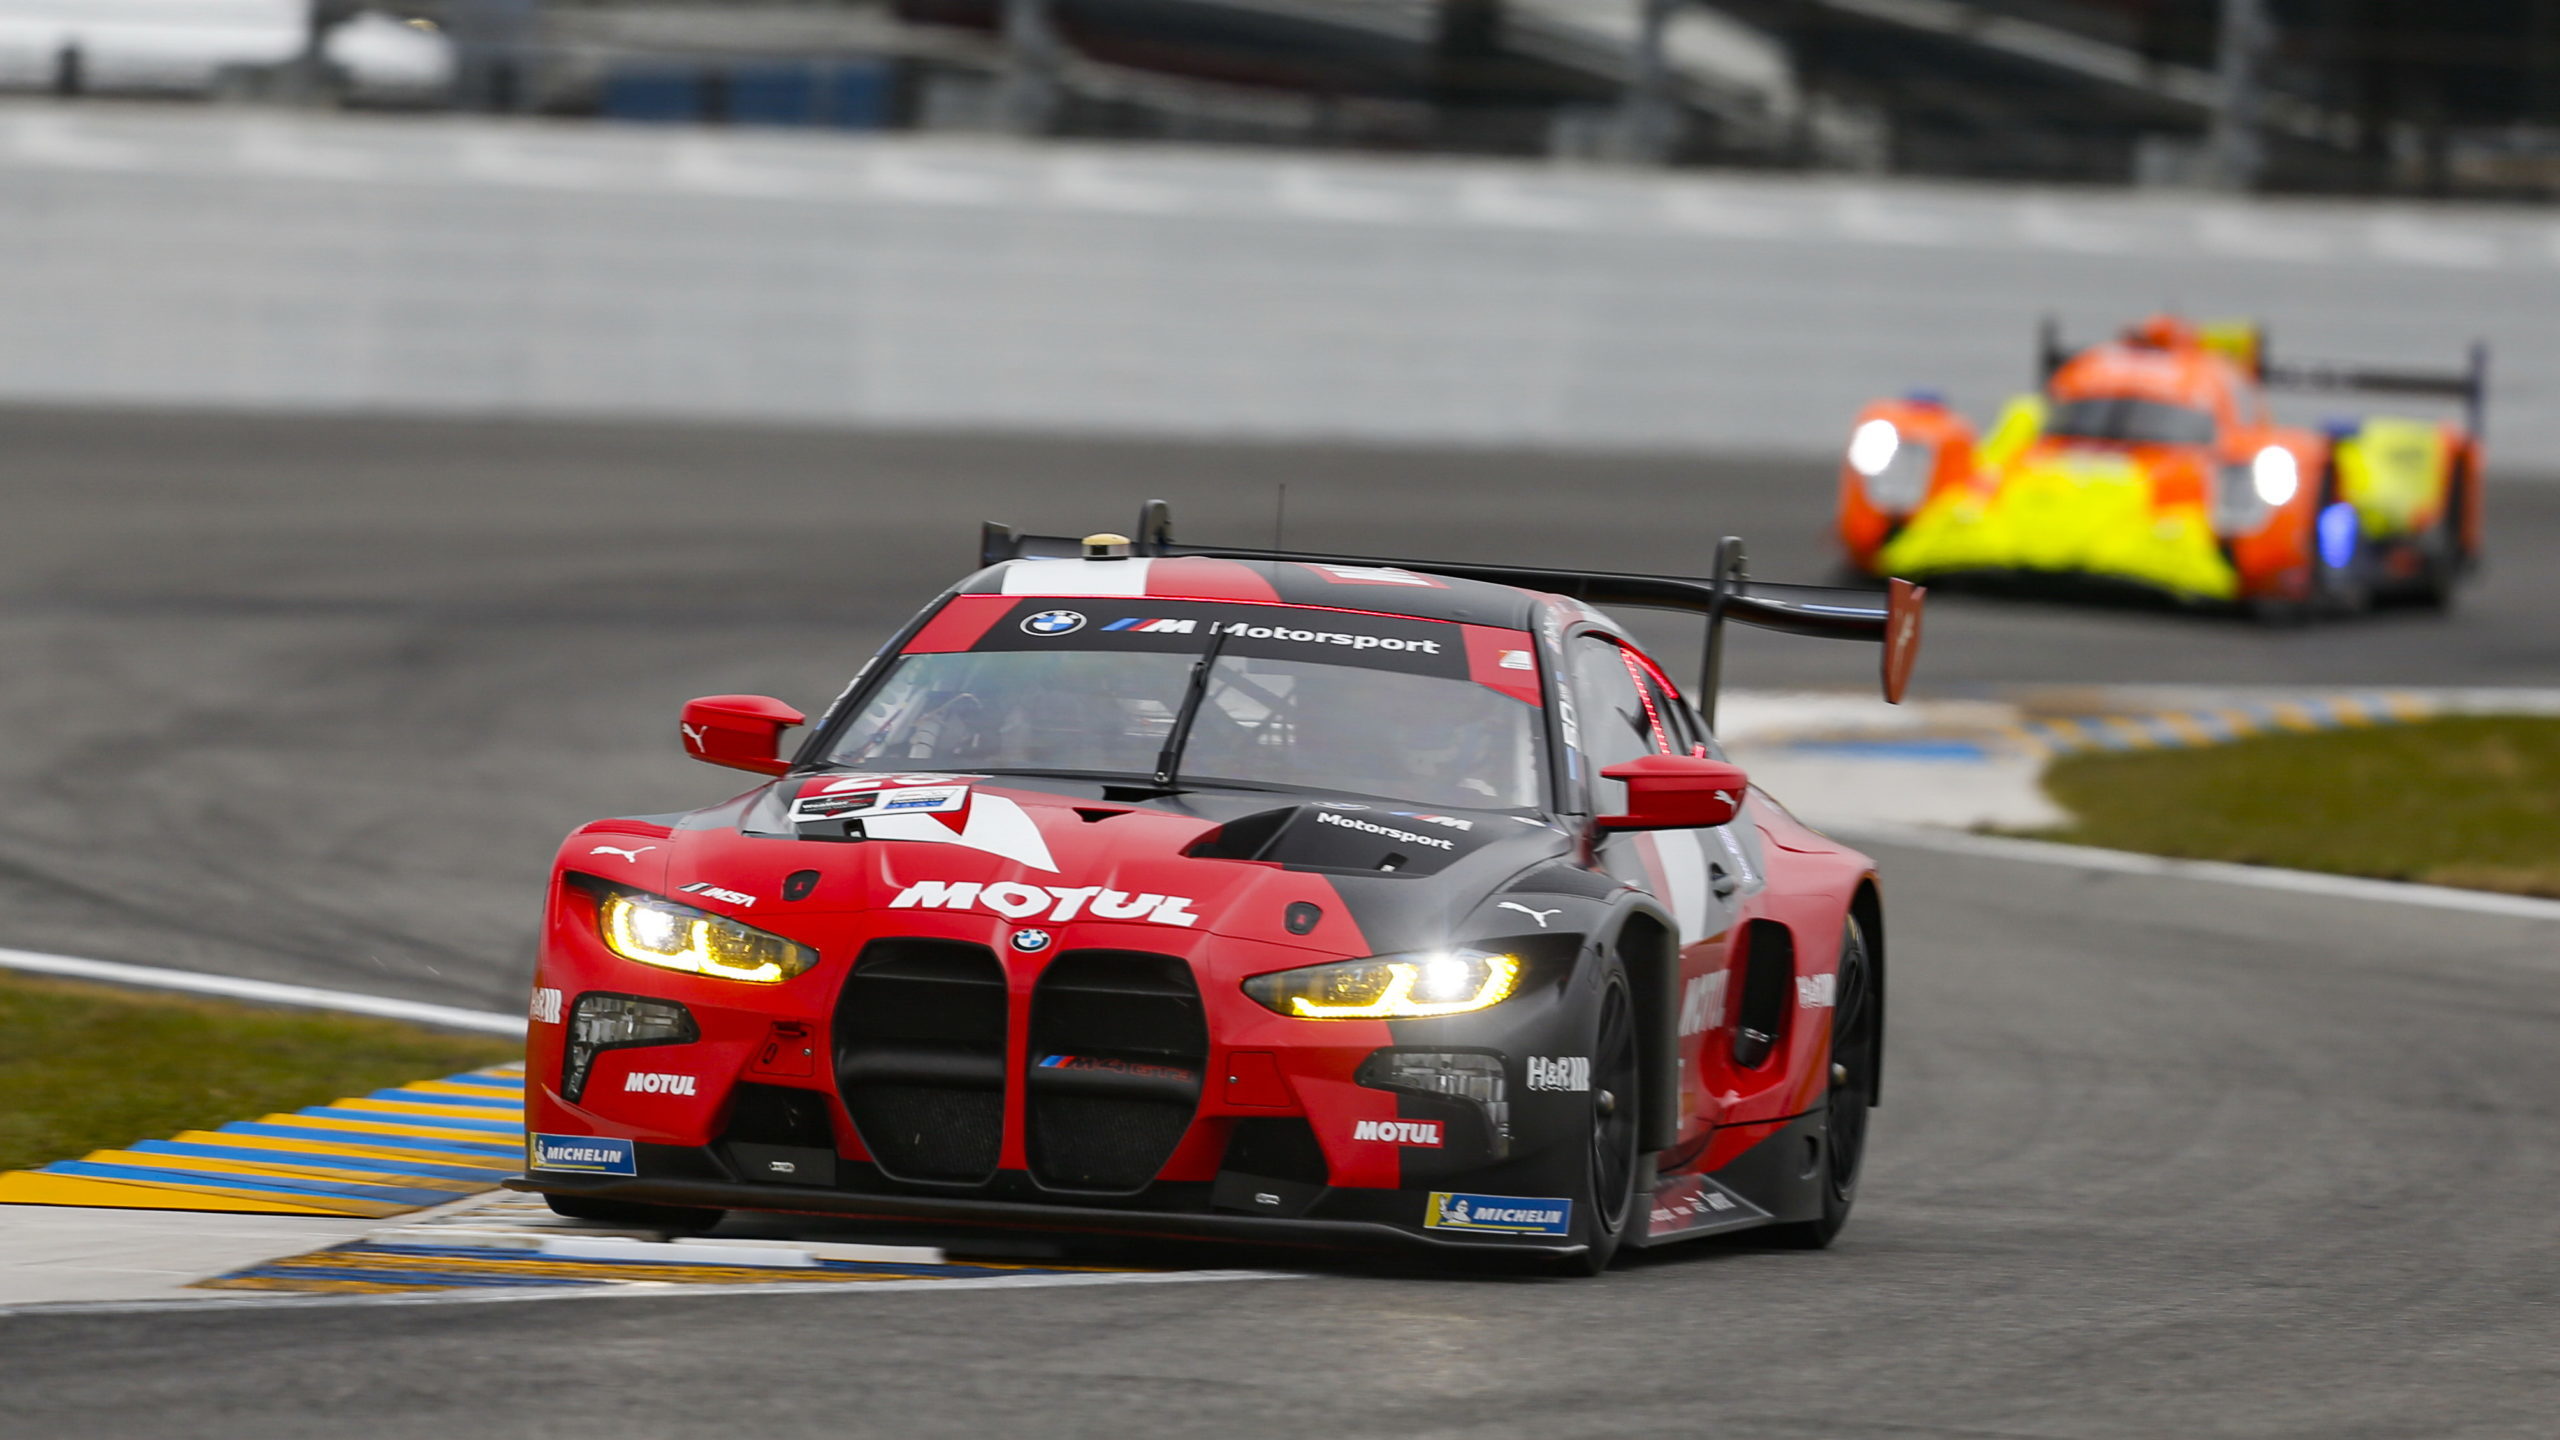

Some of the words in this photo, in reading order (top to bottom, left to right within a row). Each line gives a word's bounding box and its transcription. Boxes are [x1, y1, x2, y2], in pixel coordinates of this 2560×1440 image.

[1208, 621, 1441, 655] Motorsport
[1316, 812, 1455, 851] Motorsport
[887, 880, 1200, 927] MOTUL
[624, 1072, 696, 1096] MOTUL
[1526, 1056, 1571, 1091] H&R
[1353, 1120, 1440, 1145] MOTUL
[546, 1146, 622, 1164] MICHELIN
[1473, 1206, 1563, 1224] MICHELIN
